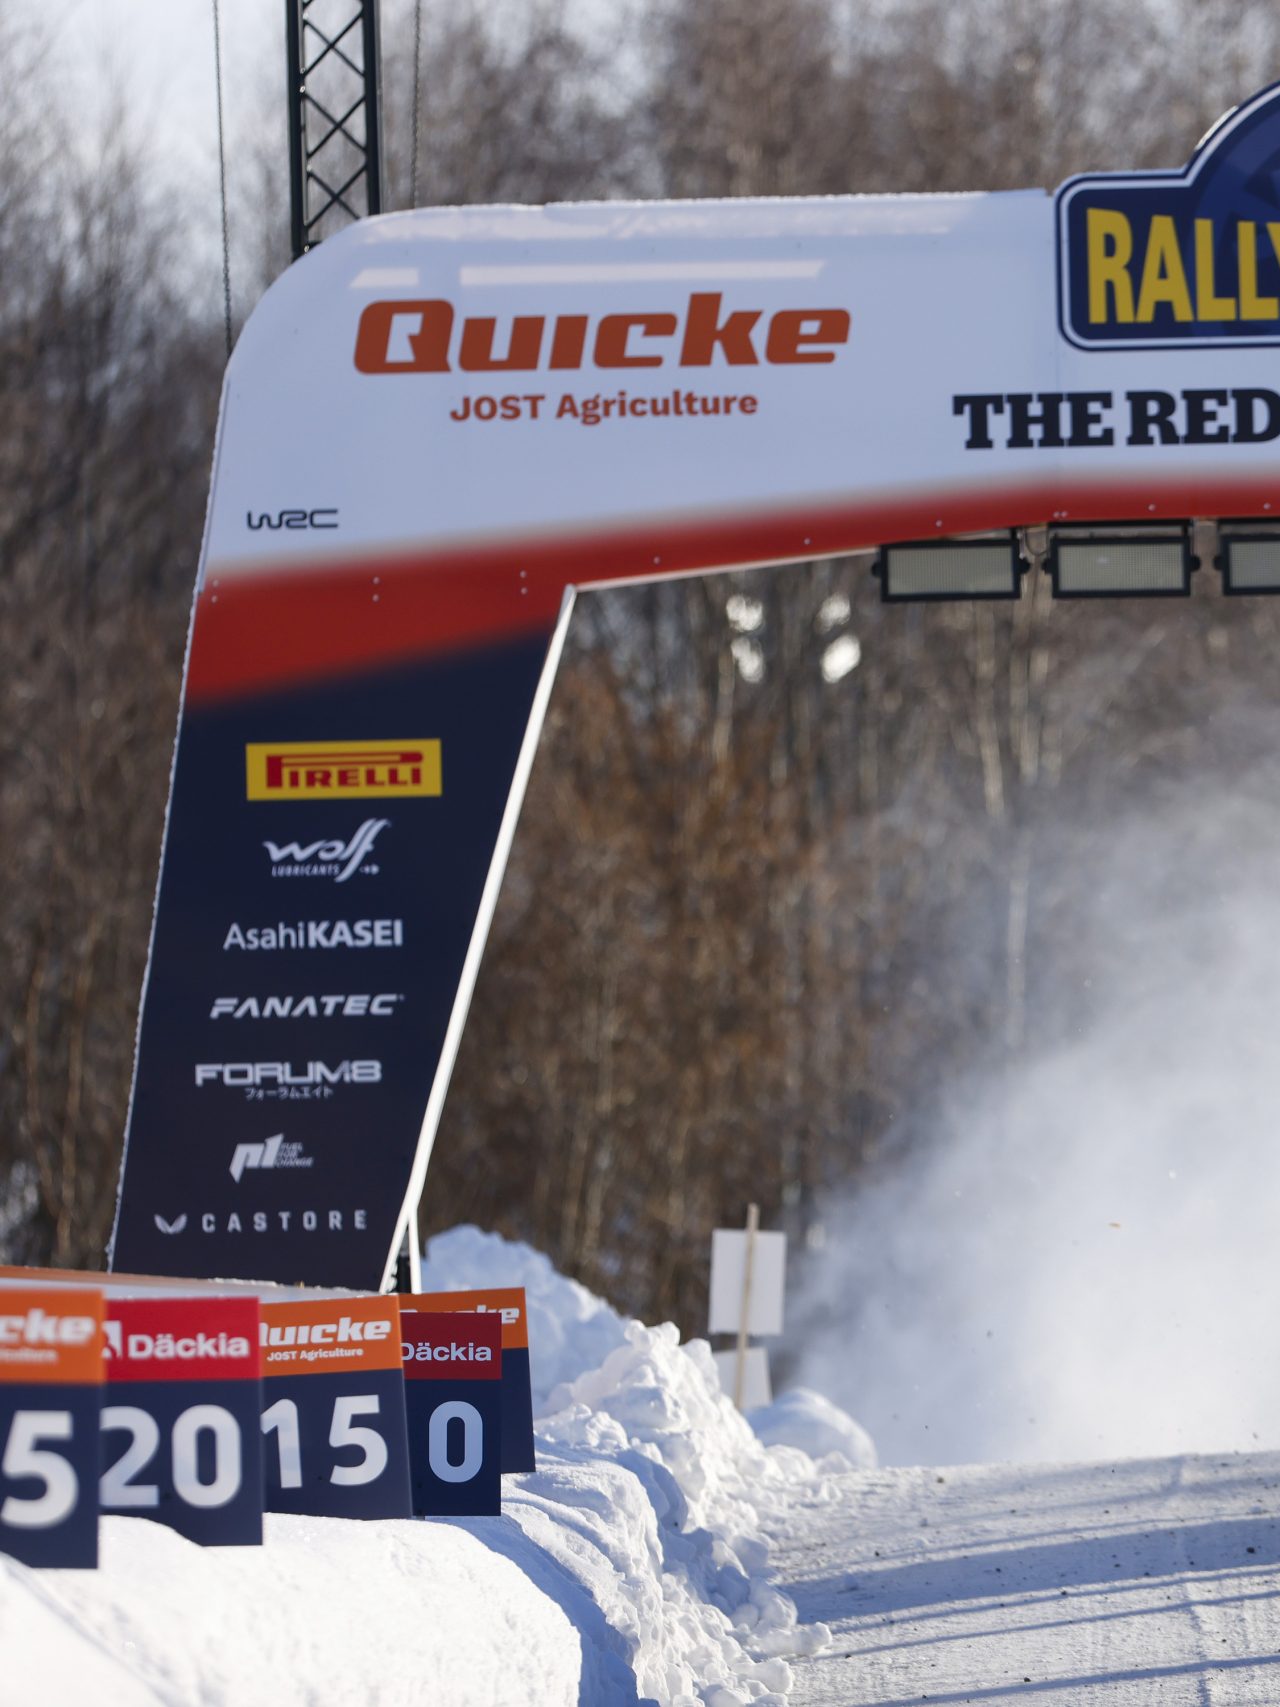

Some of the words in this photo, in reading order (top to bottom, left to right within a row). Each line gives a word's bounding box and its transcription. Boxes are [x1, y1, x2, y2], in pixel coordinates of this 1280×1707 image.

[354, 292, 851, 374] Quicke
[450, 395, 546, 421] JOST
[556, 389, 759, 425] Agriculture
[952, 391, 1114, 450] THE
[247, 509, 338, 530] WRC
[266, 751, 423, 789] PIRELLI
[209, 994, 398, 1020] FANATEC
[195, 1060, 382, 1086] FORUM8
[202, 1210, 367, 1232] CASTORE
[128, 1332, 249, 1360] Däckia
[260, 1317, 391, 1347] uicke
[267, 1350, 296, 1362] JOST
[299, 1346, 364, 1361] Agriculture
[400, 1342, 492, 1361] Däckia
[2, 1410, 79, 1529] 5
[100, 1406, 241, 1507] 20
